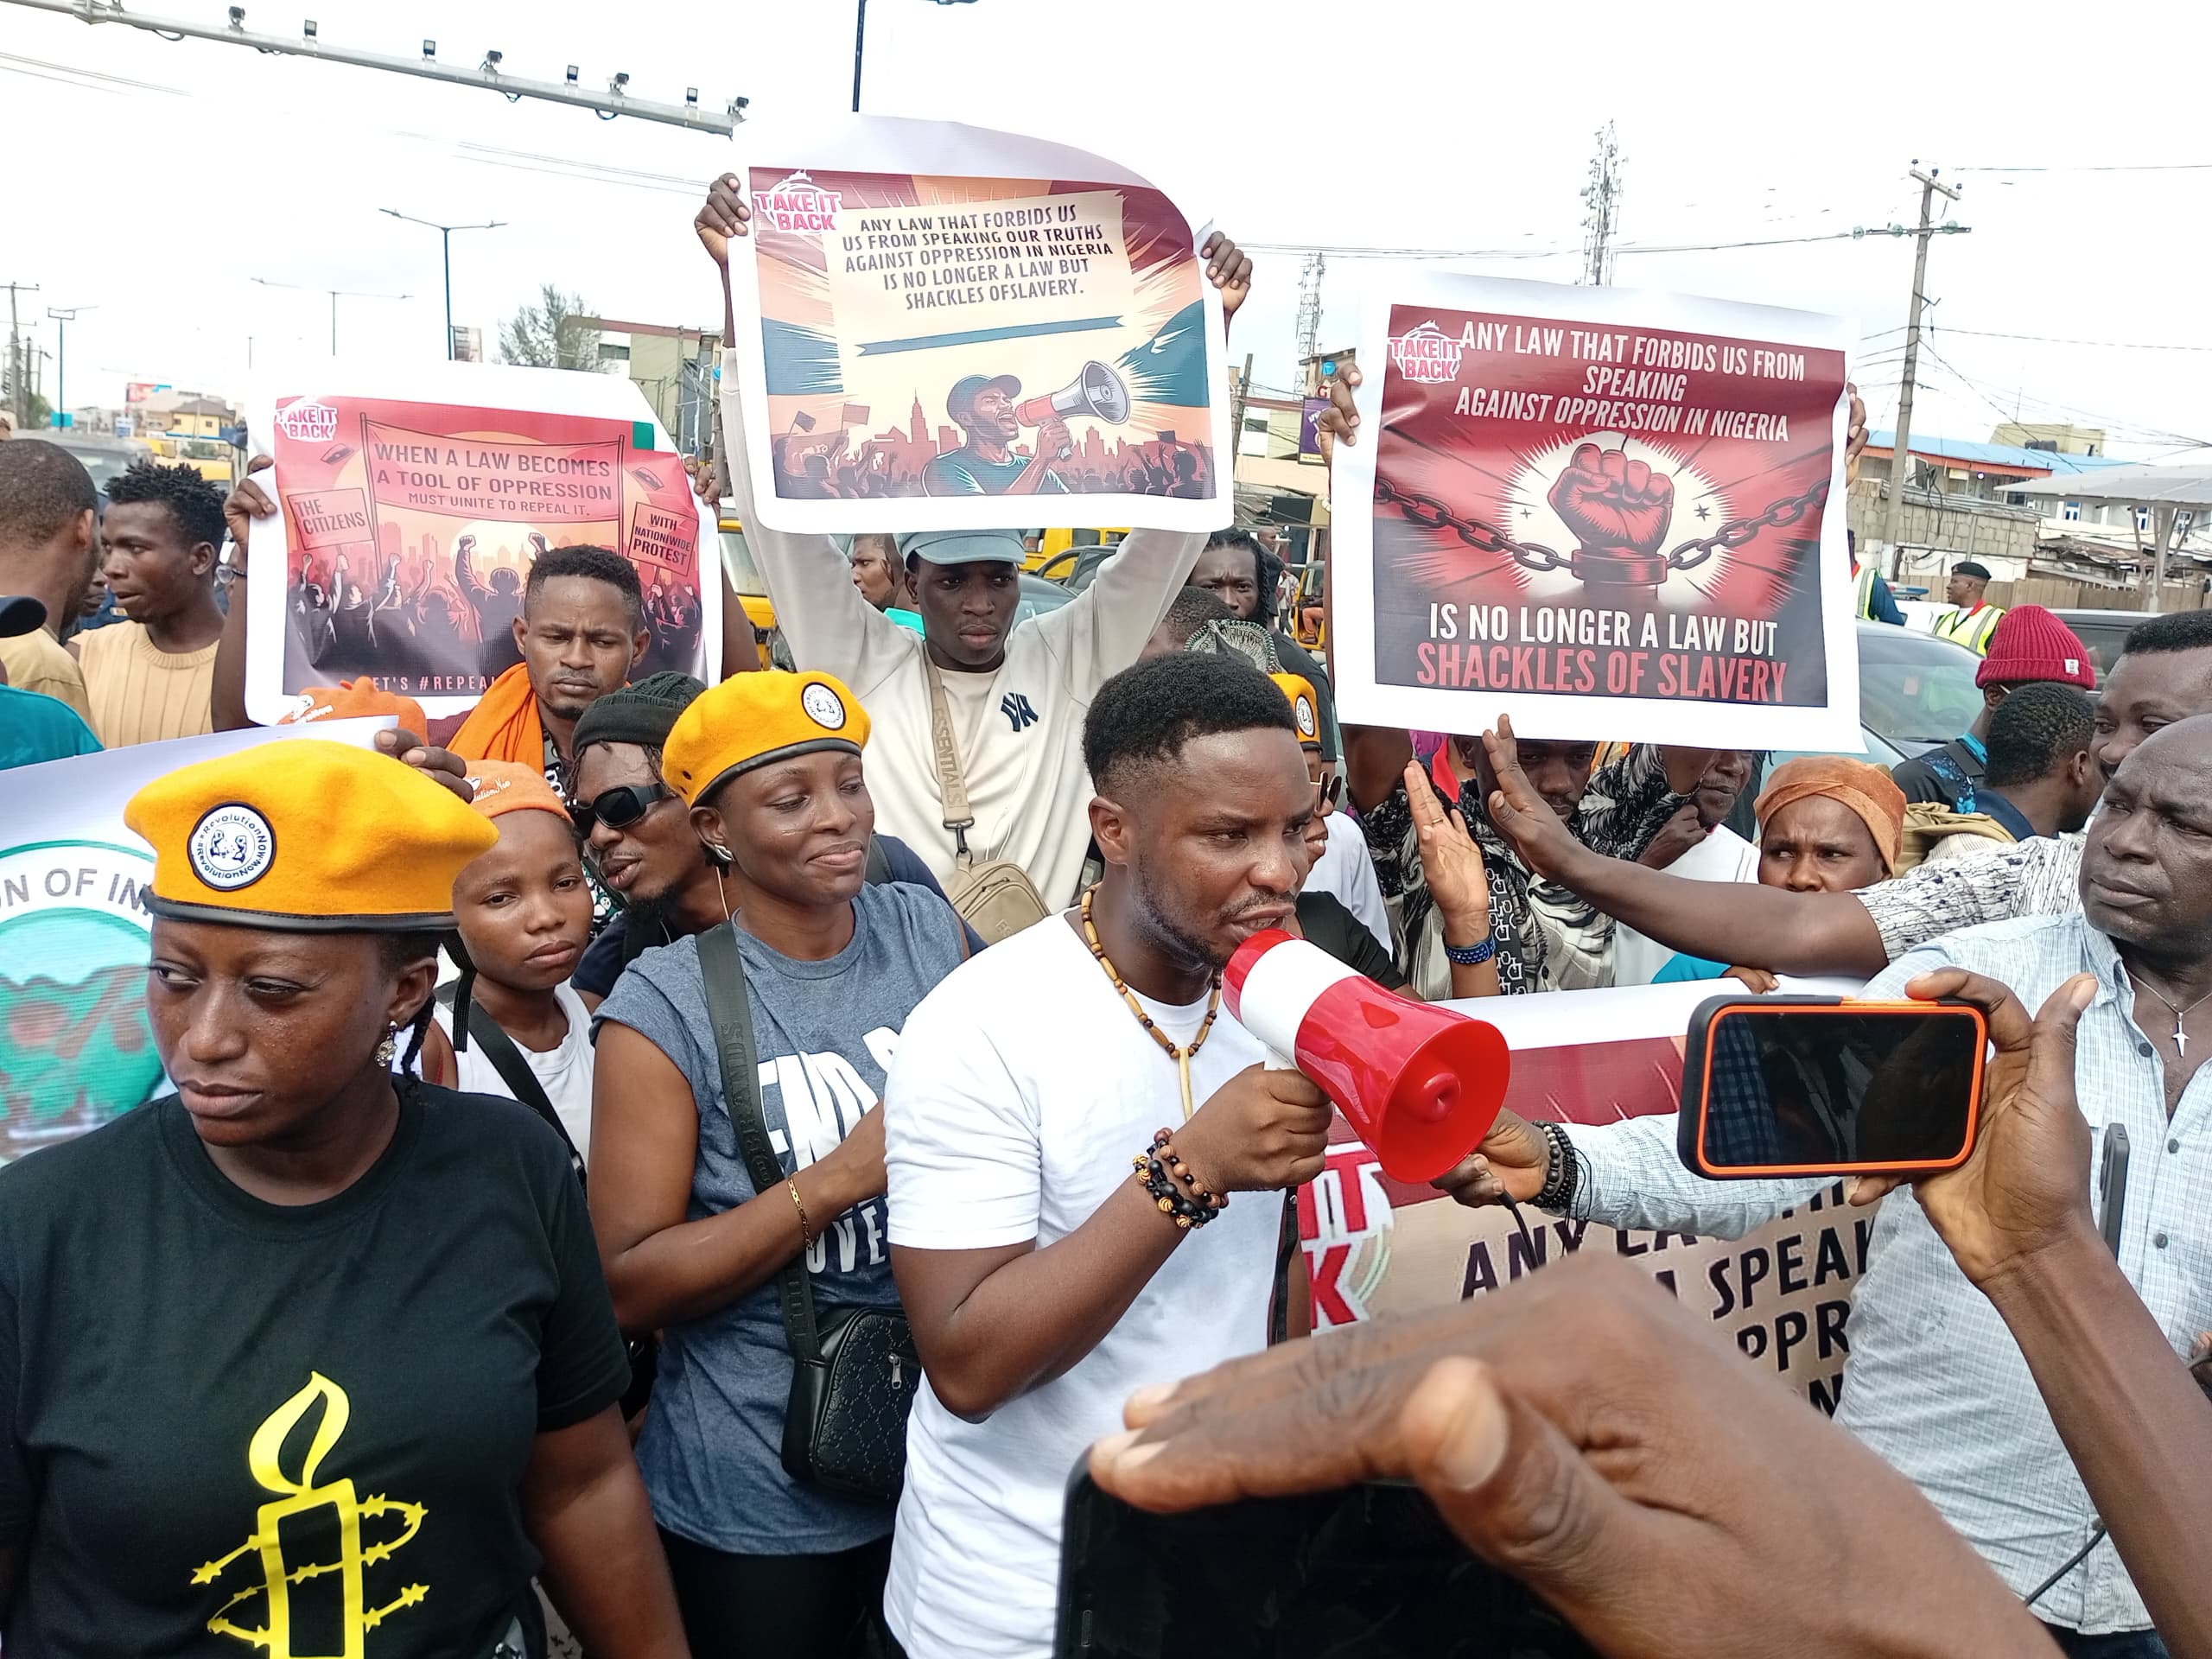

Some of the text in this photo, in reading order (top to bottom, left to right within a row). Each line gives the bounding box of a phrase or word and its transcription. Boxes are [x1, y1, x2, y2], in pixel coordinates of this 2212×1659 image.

[754, 193, 839, 213] TAKE IT
[777, 213, 837, 231] BACK
[861, 204, 1077, 232] ANY LAW THAT FORBIDS US
[842, 224, 1103, 251] US FROM SPEAKING OUR TRUTHS
[846, 243, 1114, 273] AGAINST OPPRESSION IN NIGERIA
[883, 258, 1089, 290] IS NO LONGER A LAW BUT
[906, 286, 984, 310] SHACKLES
[1389, 339, 1460, 359] TAKE IT
[1460, 321, 1805, 381] ANY LAW THAT FORBIDS US FROM
[1405, 359, 1452, 379] BACK
[1582, 365, 1688, 402] SPEAKING
[276, 409, 335, 423] TAKE IT
[1454, 386, 1789, 442] AGAINST OPPRESSION IN NIGERIA
[289, 423, 330, 438] BACK
[374, 443, 610, 477] WHEN A LAW BECOMES
[377, 469, 612, 500] A TOOL OF OPPRESSION
[294, 499, 324, 517] THE
[409, 493, 590, 516] MUST UINITE TO REPEAL IT.
[302, 512, 365, 535] CITIZENS
[650, 513, 677, 531] WITH
[633, 538, 687, 565] PROTEST
[1430, 602, 1778, 657] IS NO LONGER A LAW BUT
[372, 677, 409, 690] ET'S
[1416, 642, 1788, 702] SHACKLES OF SLAVERY
[45, 868, 98, 897] OF
